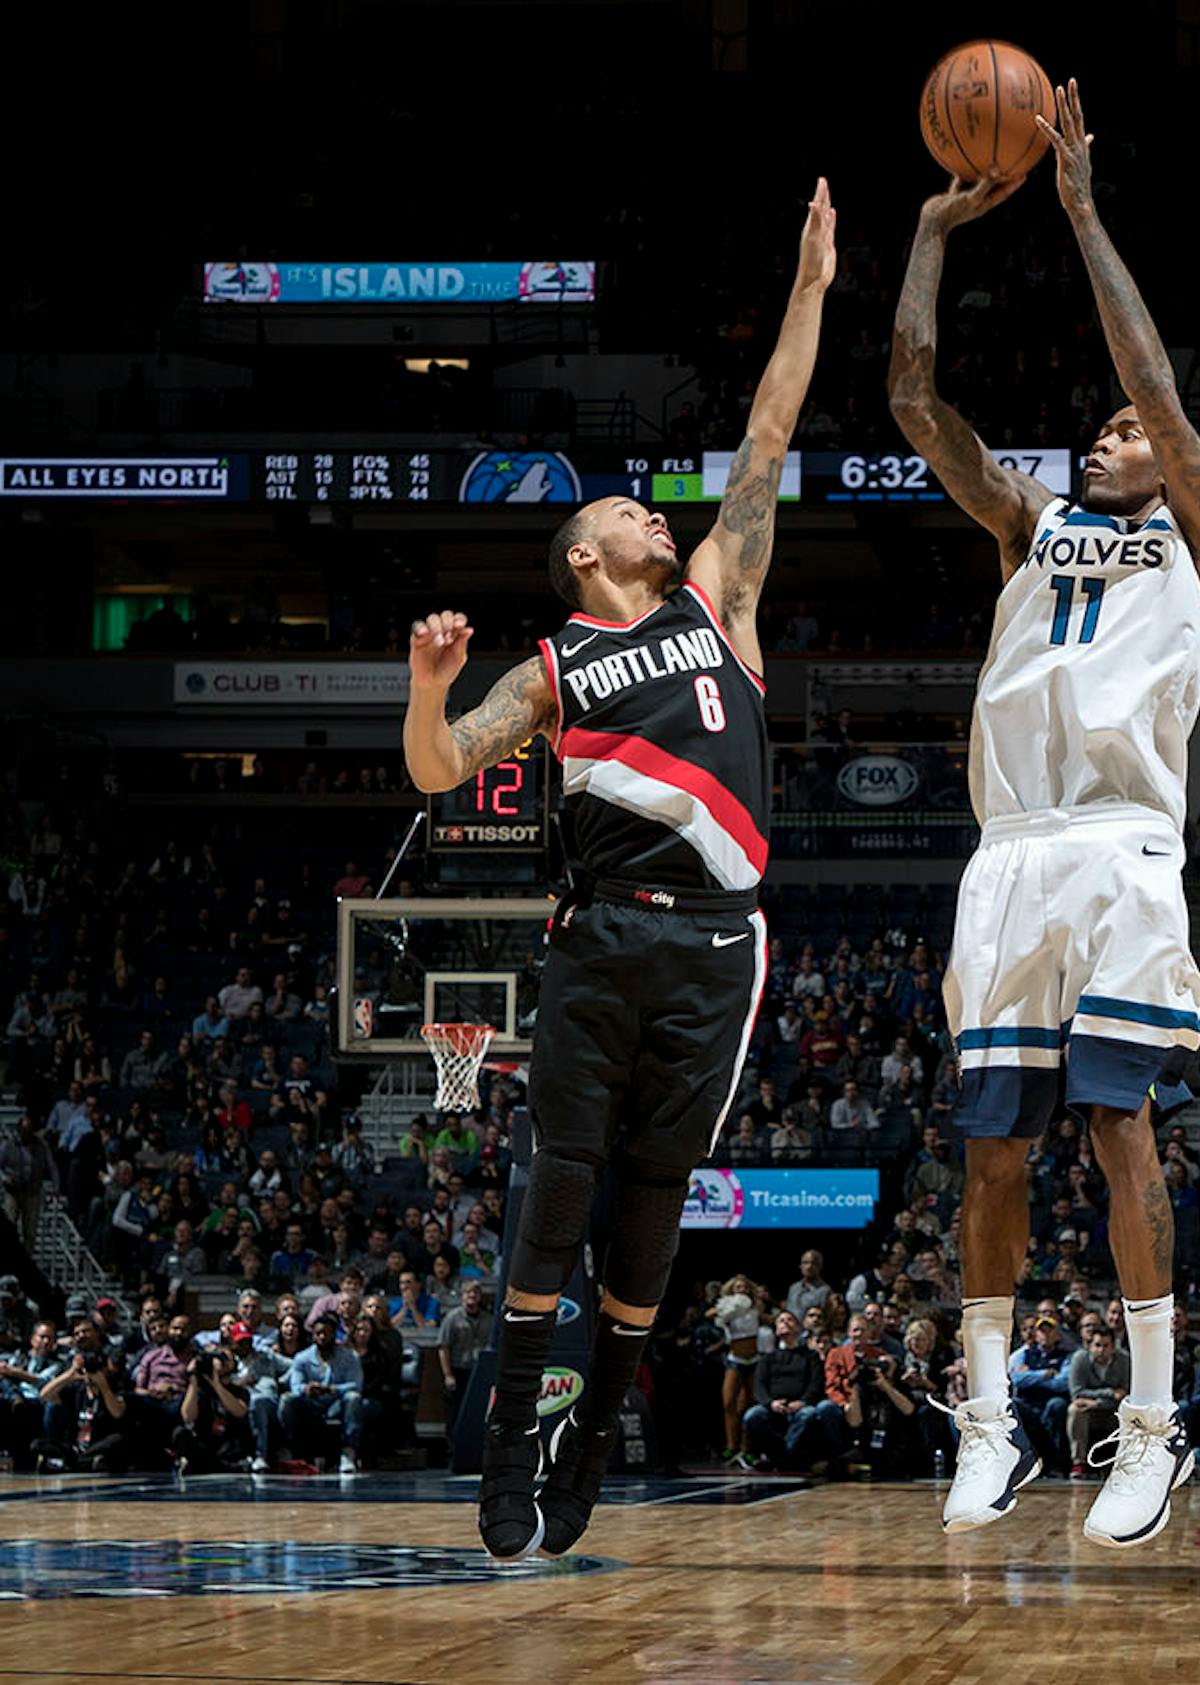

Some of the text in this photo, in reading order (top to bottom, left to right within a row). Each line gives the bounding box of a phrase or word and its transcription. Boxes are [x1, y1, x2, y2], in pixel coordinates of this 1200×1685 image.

[287, 269, 317, 283] IT'S
[322, 267, 464, 297] ISLAND
[468, 282, 513, 298] TIME
[265, 455, 298, 470] REB
[352, 455, 390, 470] FG%
[409, 454, 430, 468] 45
[626, 459, 694, 473] TO FLS
[10, 468, 227, 487] ALL EYES NORTH
[265, 470, 298, 485] AST
[352, 470, 389, 484] FT%
[410, 470, 430, 484] 73
[840, 456, 928, 489] 6:32
[265, 485, 298, 500] STL
[350, 485, 393, 500] 3PT%
[408, 486, 429, 500] 44
[630, 477, 686, 496] 1 3
[1025, 538, 1164, 569] WOLVES
[1050, 574, 1106, 645] 11
[563, 627, 724, 712] PORTLAND
[213, 674, 280, 693] CLUB
[295, 674, 317, 692] TI
[693, 674, 727, 734] 6
[856, 767, 899, 785] FOX
[476, 762, 523, 815] 12
[463, 825, 540, 841] TISSOT
[544, 1376, 575, 1397] AN
